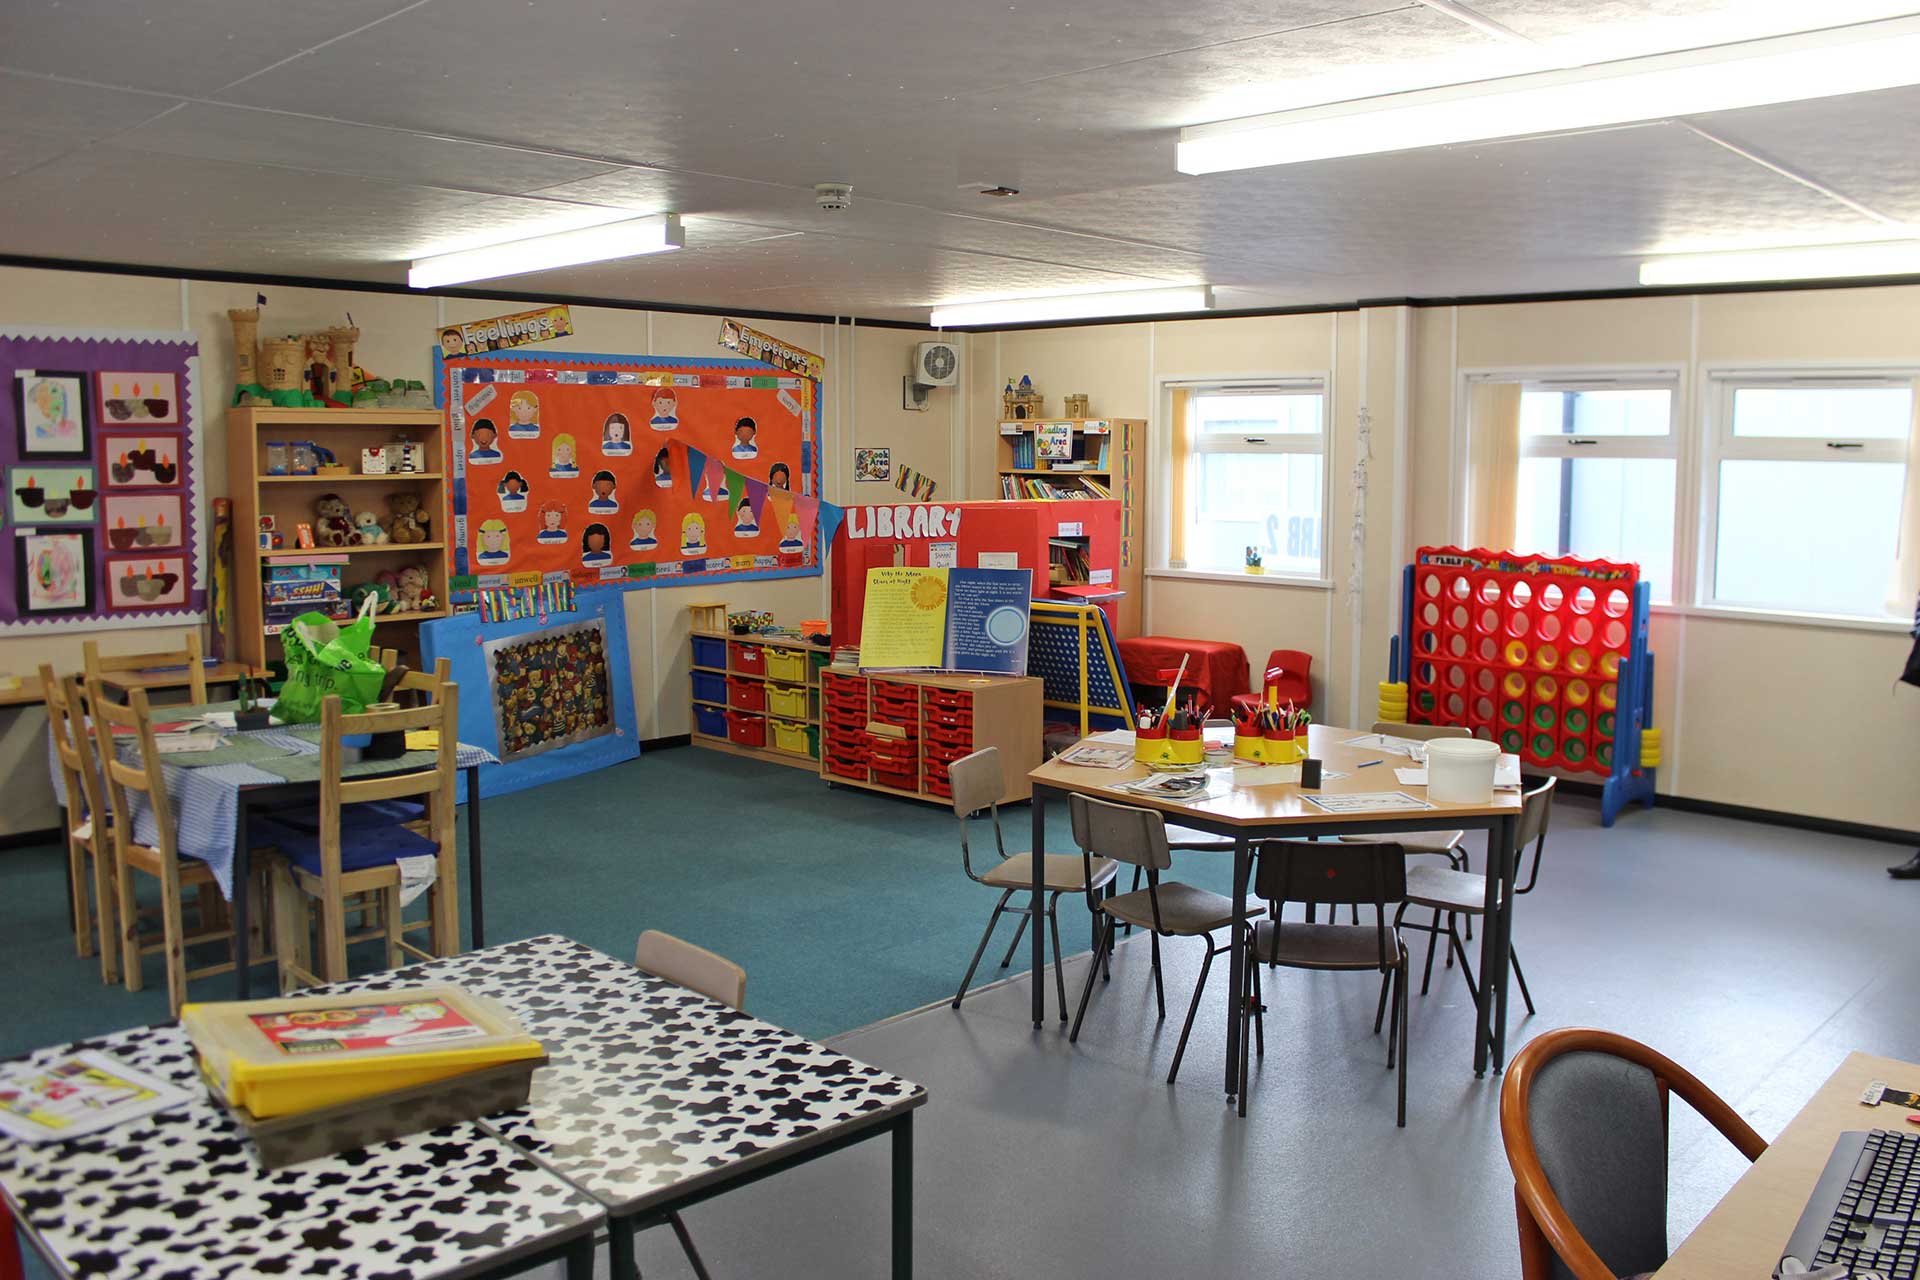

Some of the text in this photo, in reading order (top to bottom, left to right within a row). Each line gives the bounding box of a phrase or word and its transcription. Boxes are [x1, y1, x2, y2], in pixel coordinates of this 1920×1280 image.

[461, 317, 551, 344] Feelings
[741, 326, 808, 366] Emotions
[1038, 425, 1067, 437] Reading
[1049, 436, 1067, 446] Area
[868, 450, 888, 459] Book
[869, 457, 888, 465] Area
[847, 505, 961, 539] LIBRARY
[514, 574, 538, 585] unwell
